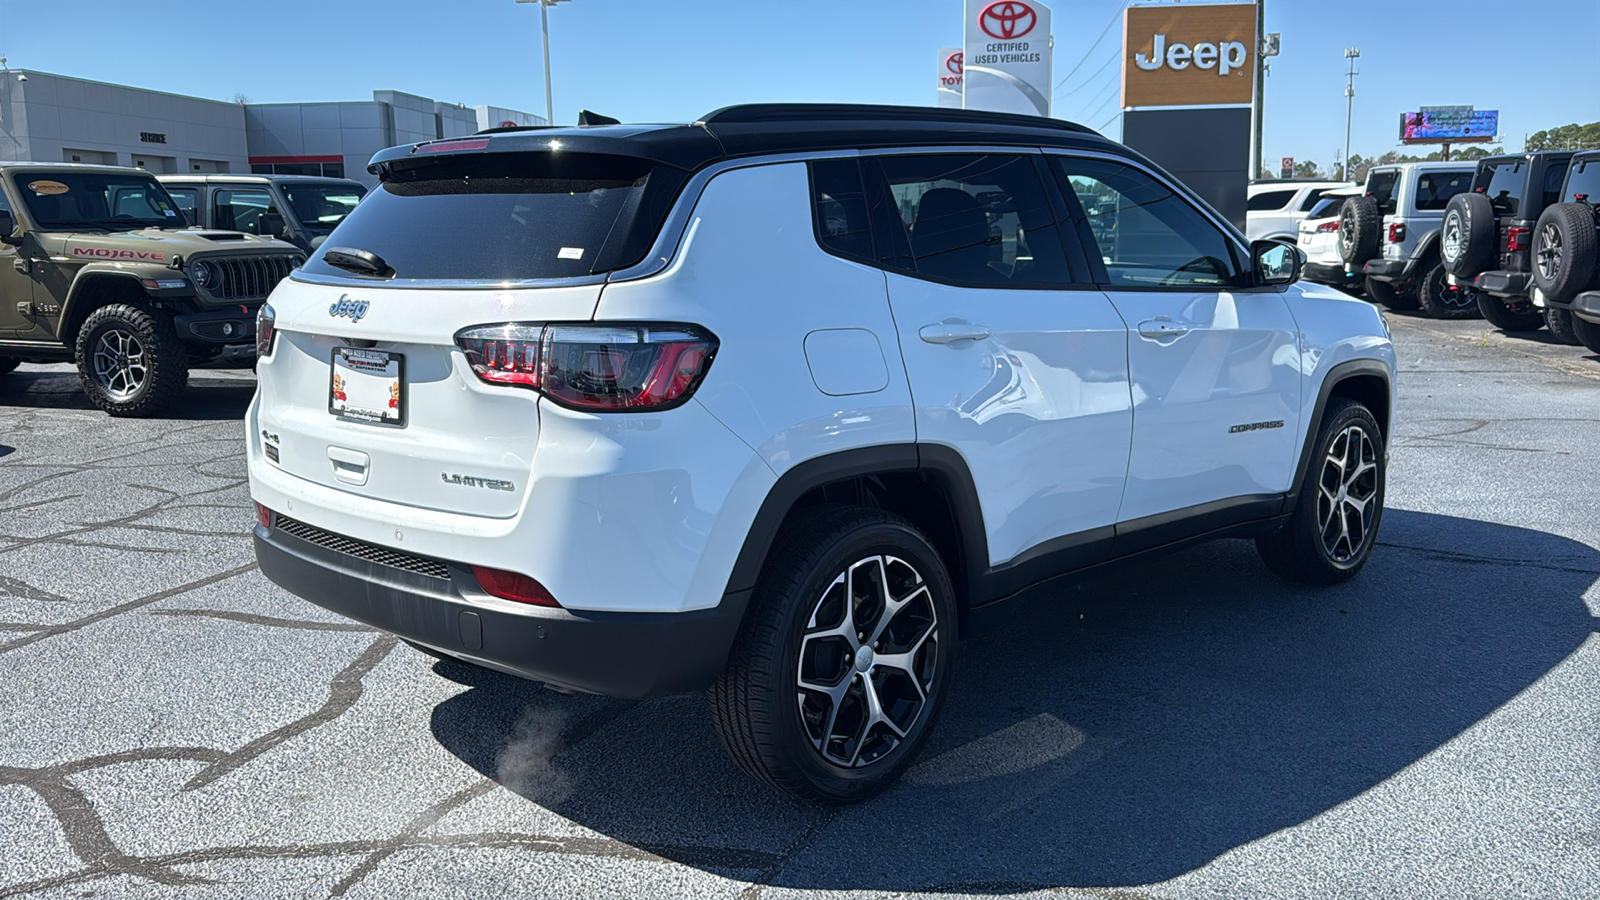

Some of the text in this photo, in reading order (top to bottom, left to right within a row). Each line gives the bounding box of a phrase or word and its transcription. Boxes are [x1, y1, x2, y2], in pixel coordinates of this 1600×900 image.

[986, 42, 1029, 52] CERTIFIED
[975, 53, 1041, 64] USED VEHICLES
[1135, 34, 1247, 76] Jeep
[73, 247, 165, 260] MOJAVE
[329, 293, 370, 323] Jeep
[1228, 419, 1284, 433] COMPASS
[441, 472, 516, 492] LIMITED
